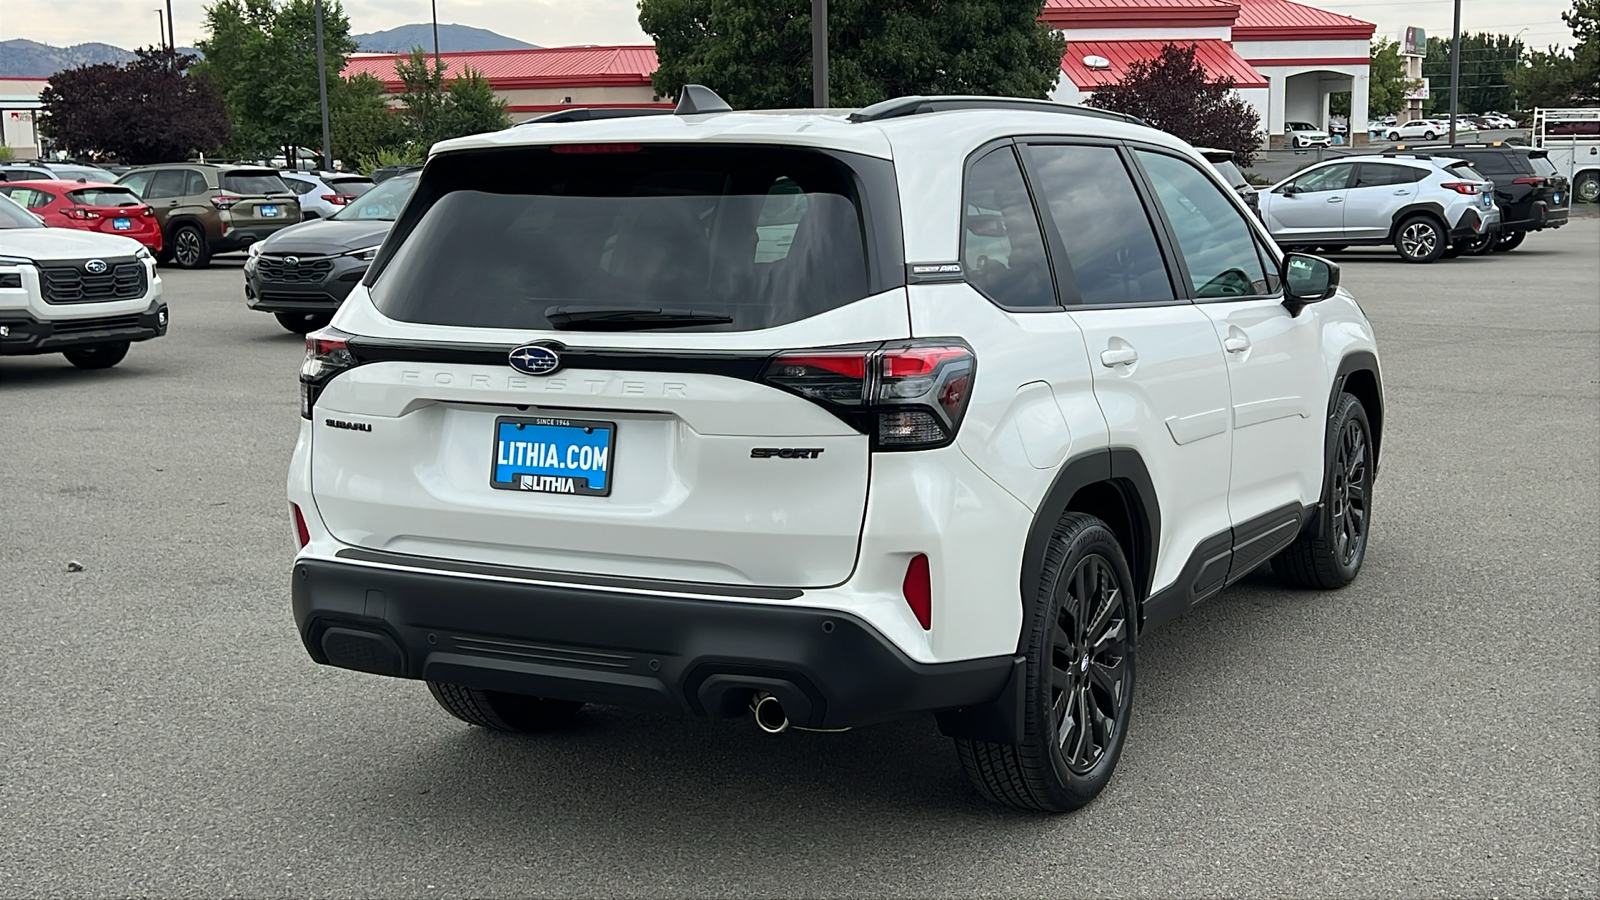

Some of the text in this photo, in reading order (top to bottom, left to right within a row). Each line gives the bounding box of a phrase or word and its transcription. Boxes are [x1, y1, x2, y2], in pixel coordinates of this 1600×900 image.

[400, 370, 688, 398] FORESTER
[325, 418, 372, 432] SUBARU
[536, 418, 570, 427] SINCE 1946
[497, 440, 609, 472] LITHIA.COM
[750, 447, 825, 459] SPORT
[532, 475, 575, 493] LITHIA
